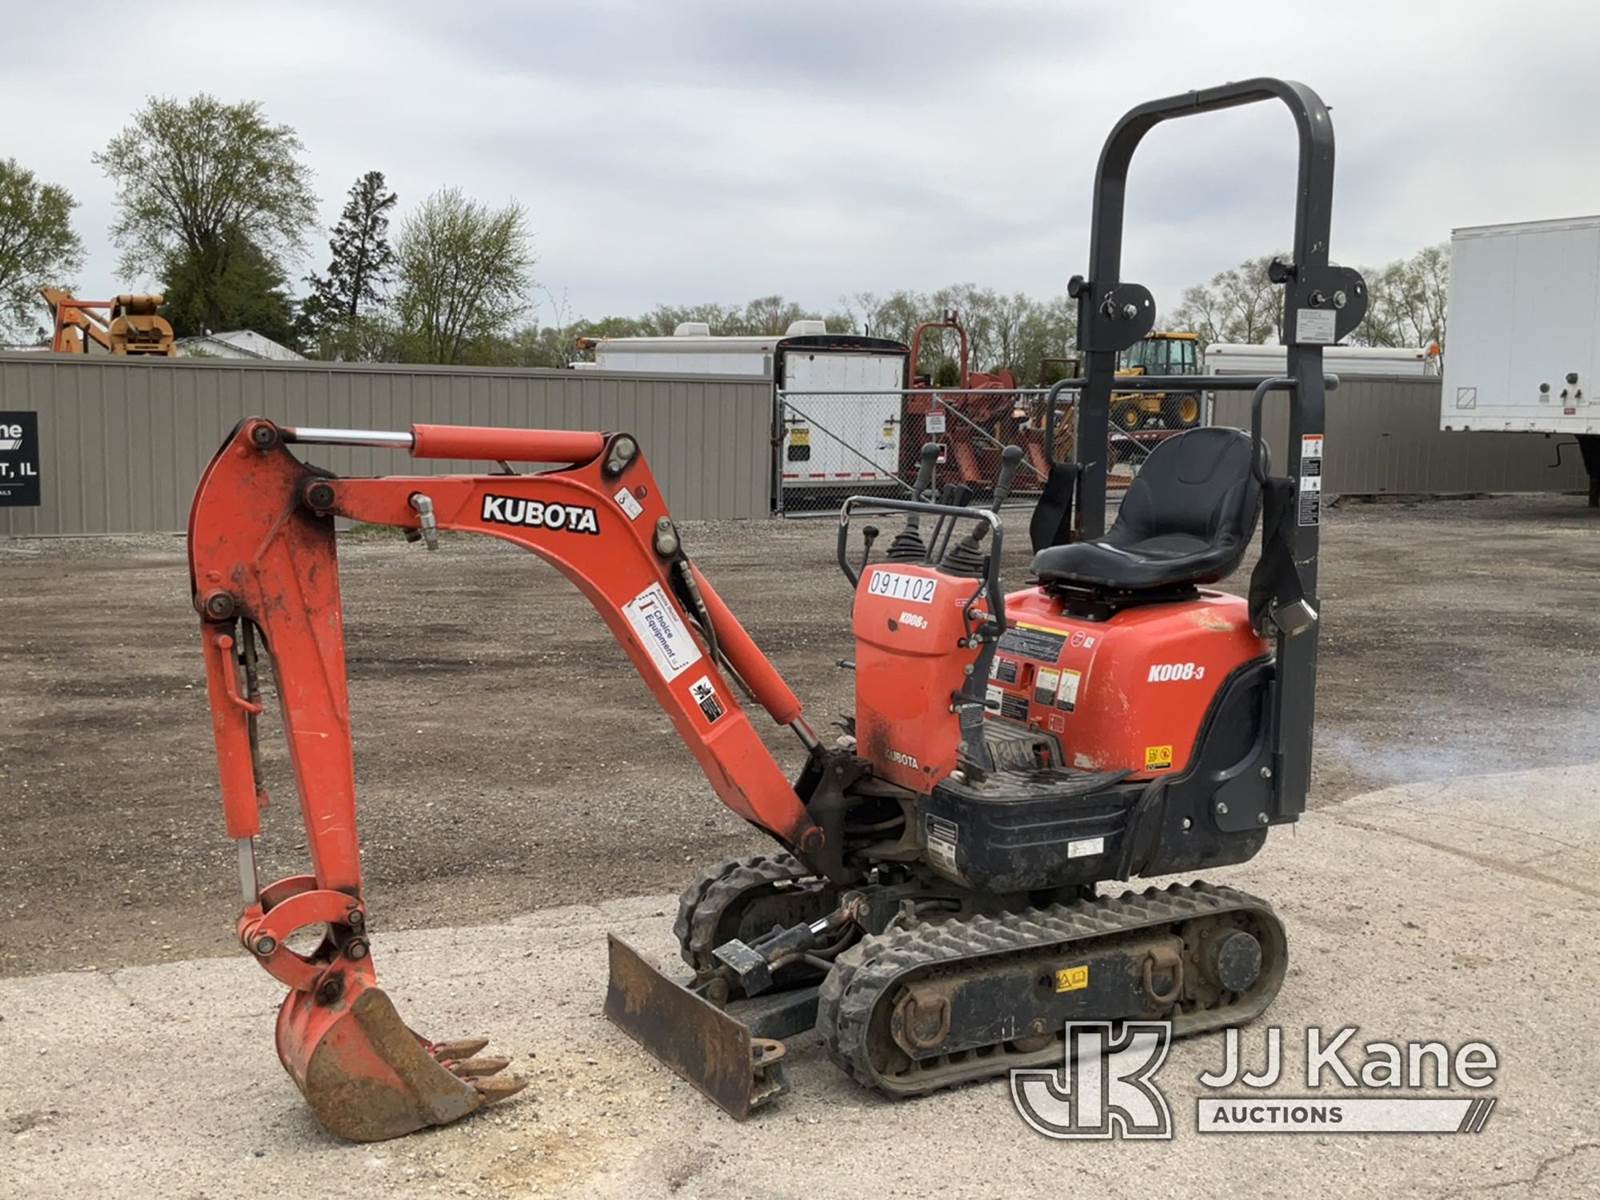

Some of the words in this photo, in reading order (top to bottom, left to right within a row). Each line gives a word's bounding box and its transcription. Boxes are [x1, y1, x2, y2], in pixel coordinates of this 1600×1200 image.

[20, 462, 37, 476] IL
[482, 495, 599, 533] KUBOTA
[870, 572, 935, 602] 091102
[645, 614, 676, 658] Equipment
[653, 610, 673, 639] Choice
[1147, 662, 1205, 682] K008-3
